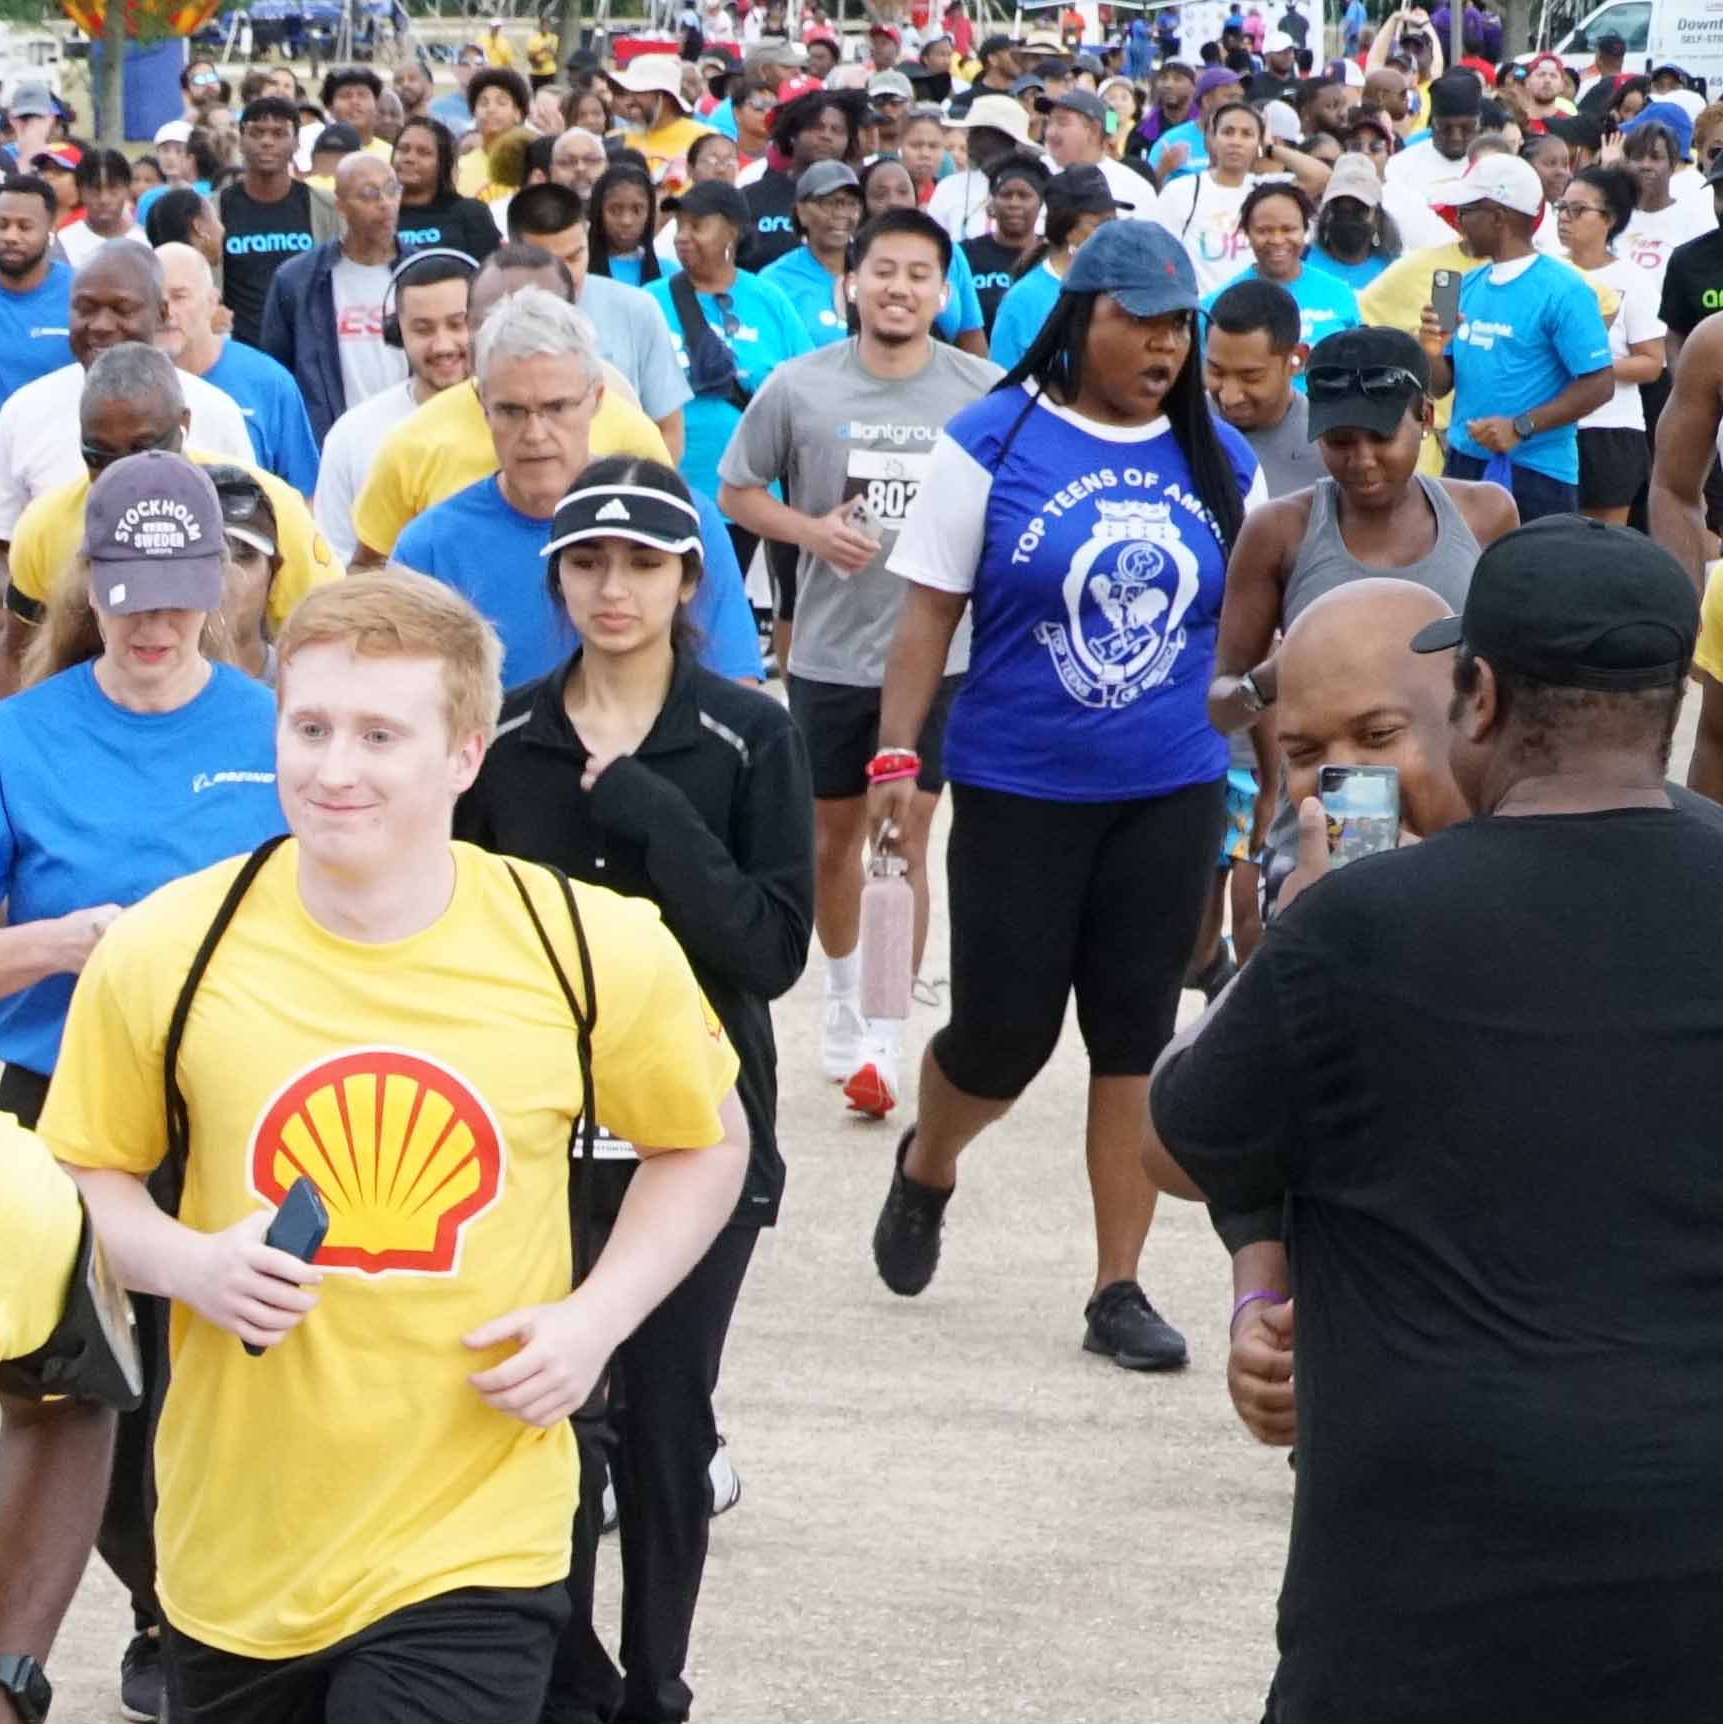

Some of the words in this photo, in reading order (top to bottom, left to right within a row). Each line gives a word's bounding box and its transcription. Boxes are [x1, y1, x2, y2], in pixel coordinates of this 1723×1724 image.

[226, 232, 313, 254] aramco
[115, 498, 203, 543] STOCKHOLM
[1011, 518, 1048, 564] TOP
[1043, 468, 1118, 518] TEENS
[1123, 467, 1160, 489] OF
